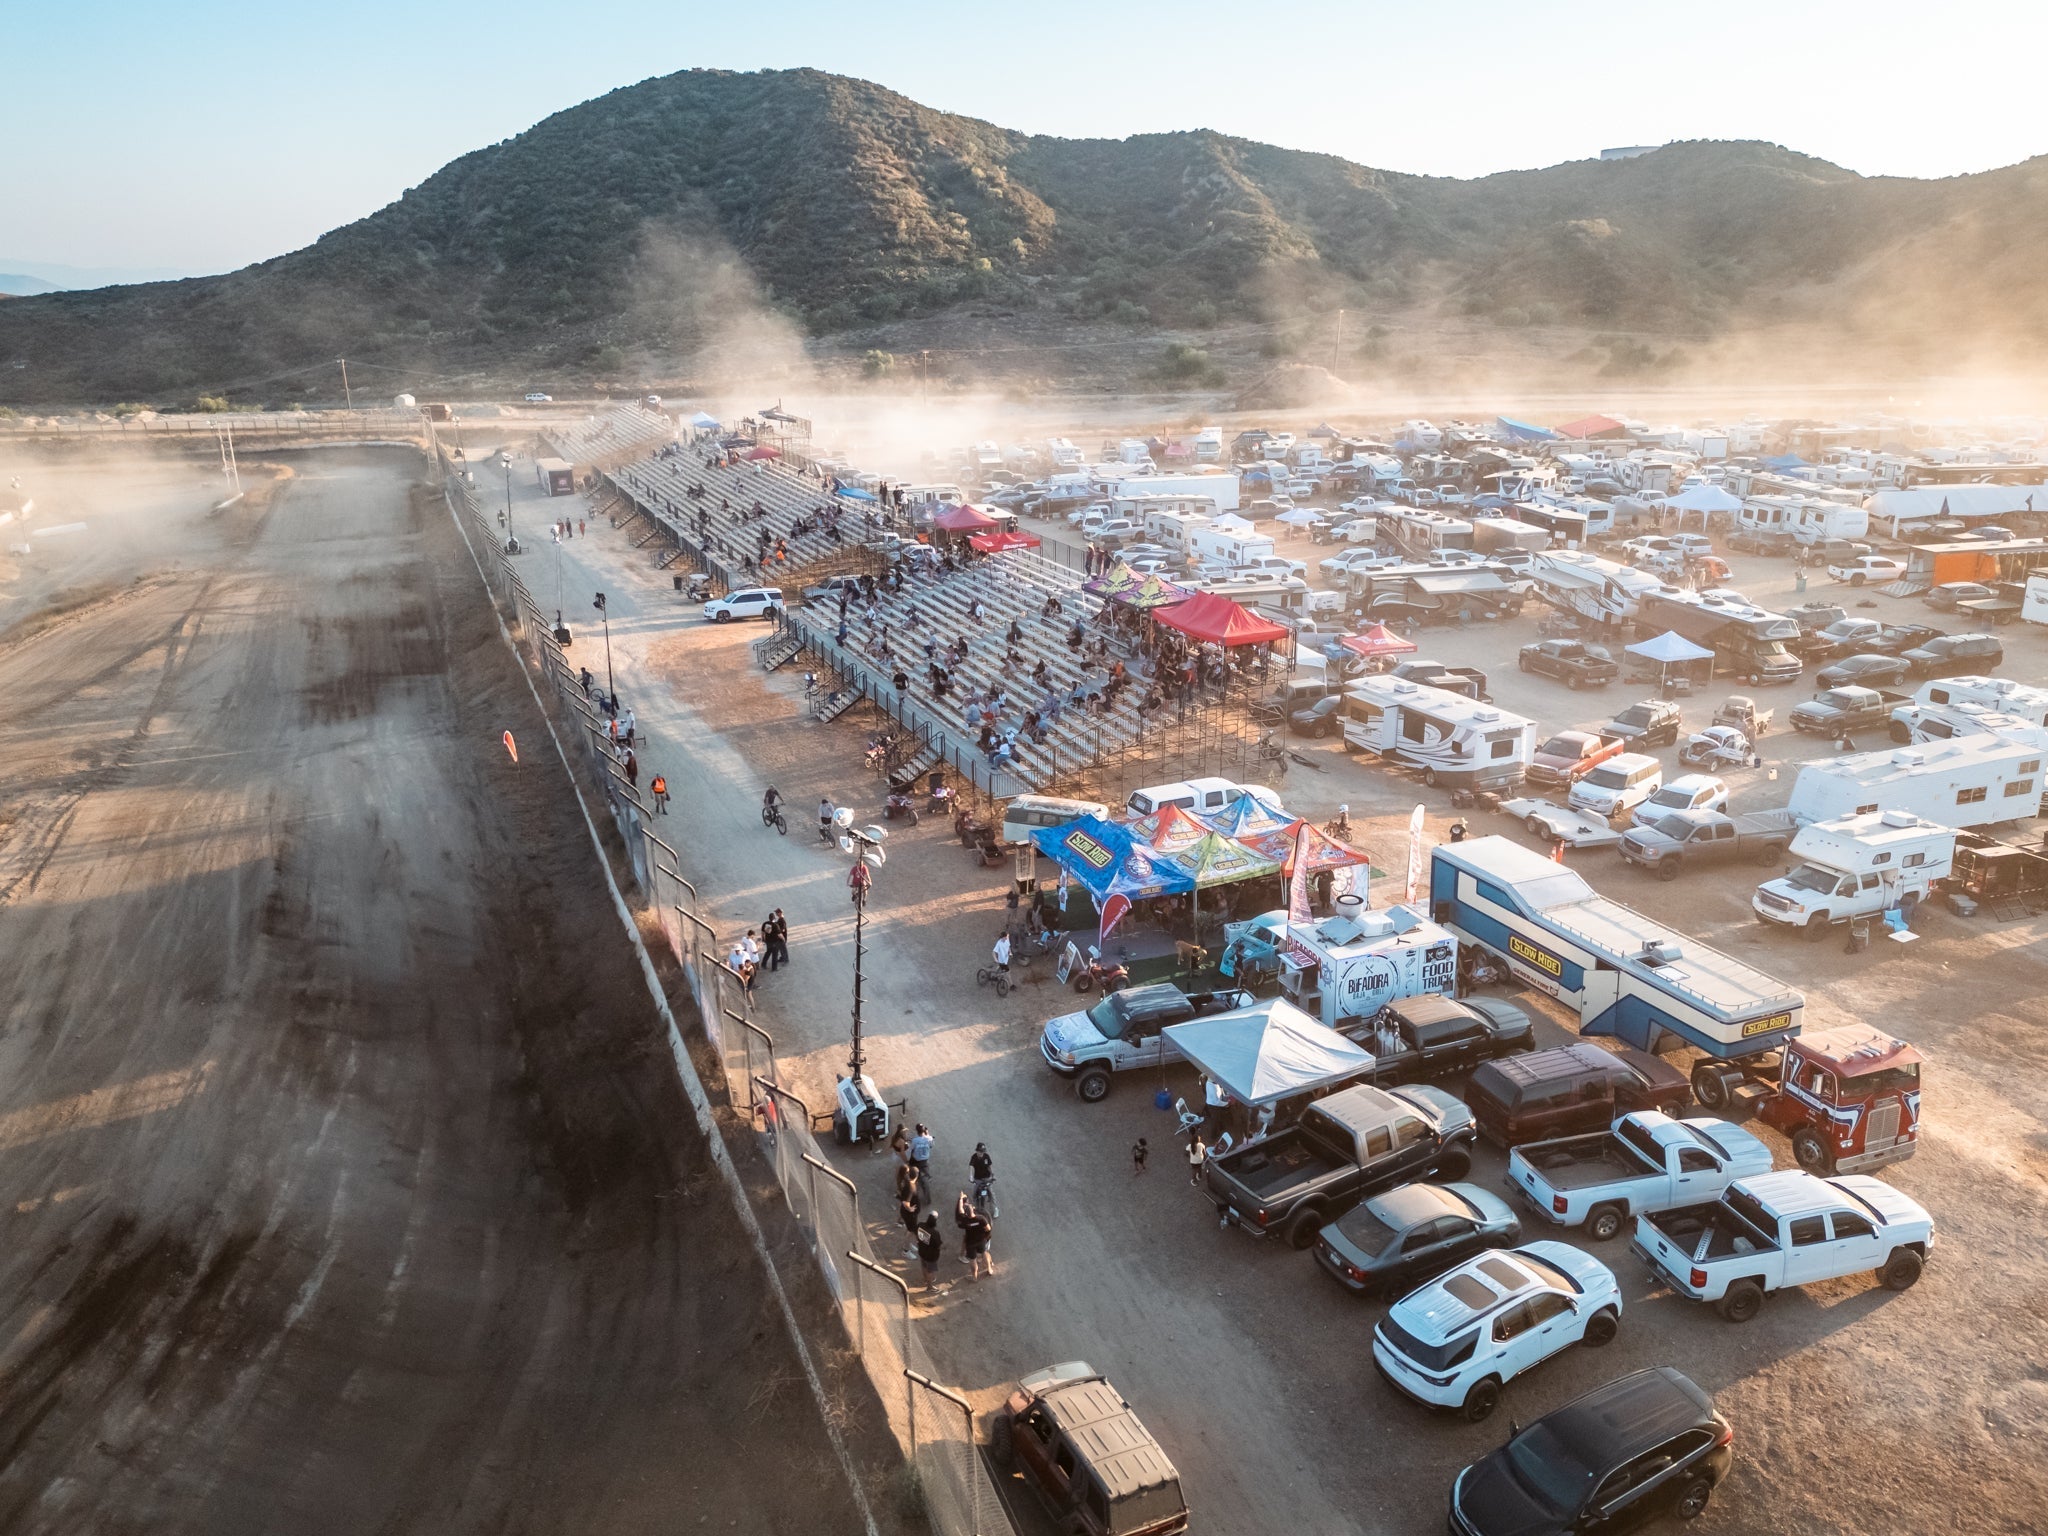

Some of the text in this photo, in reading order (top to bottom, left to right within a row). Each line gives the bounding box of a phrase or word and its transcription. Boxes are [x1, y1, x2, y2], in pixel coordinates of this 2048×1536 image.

[1514, 940, 1558, 971] SLOW RIDE
[1422, 961, 1454, 978] FOOD
[1748, 1016, 1787, 1033] SLOW RIDE
